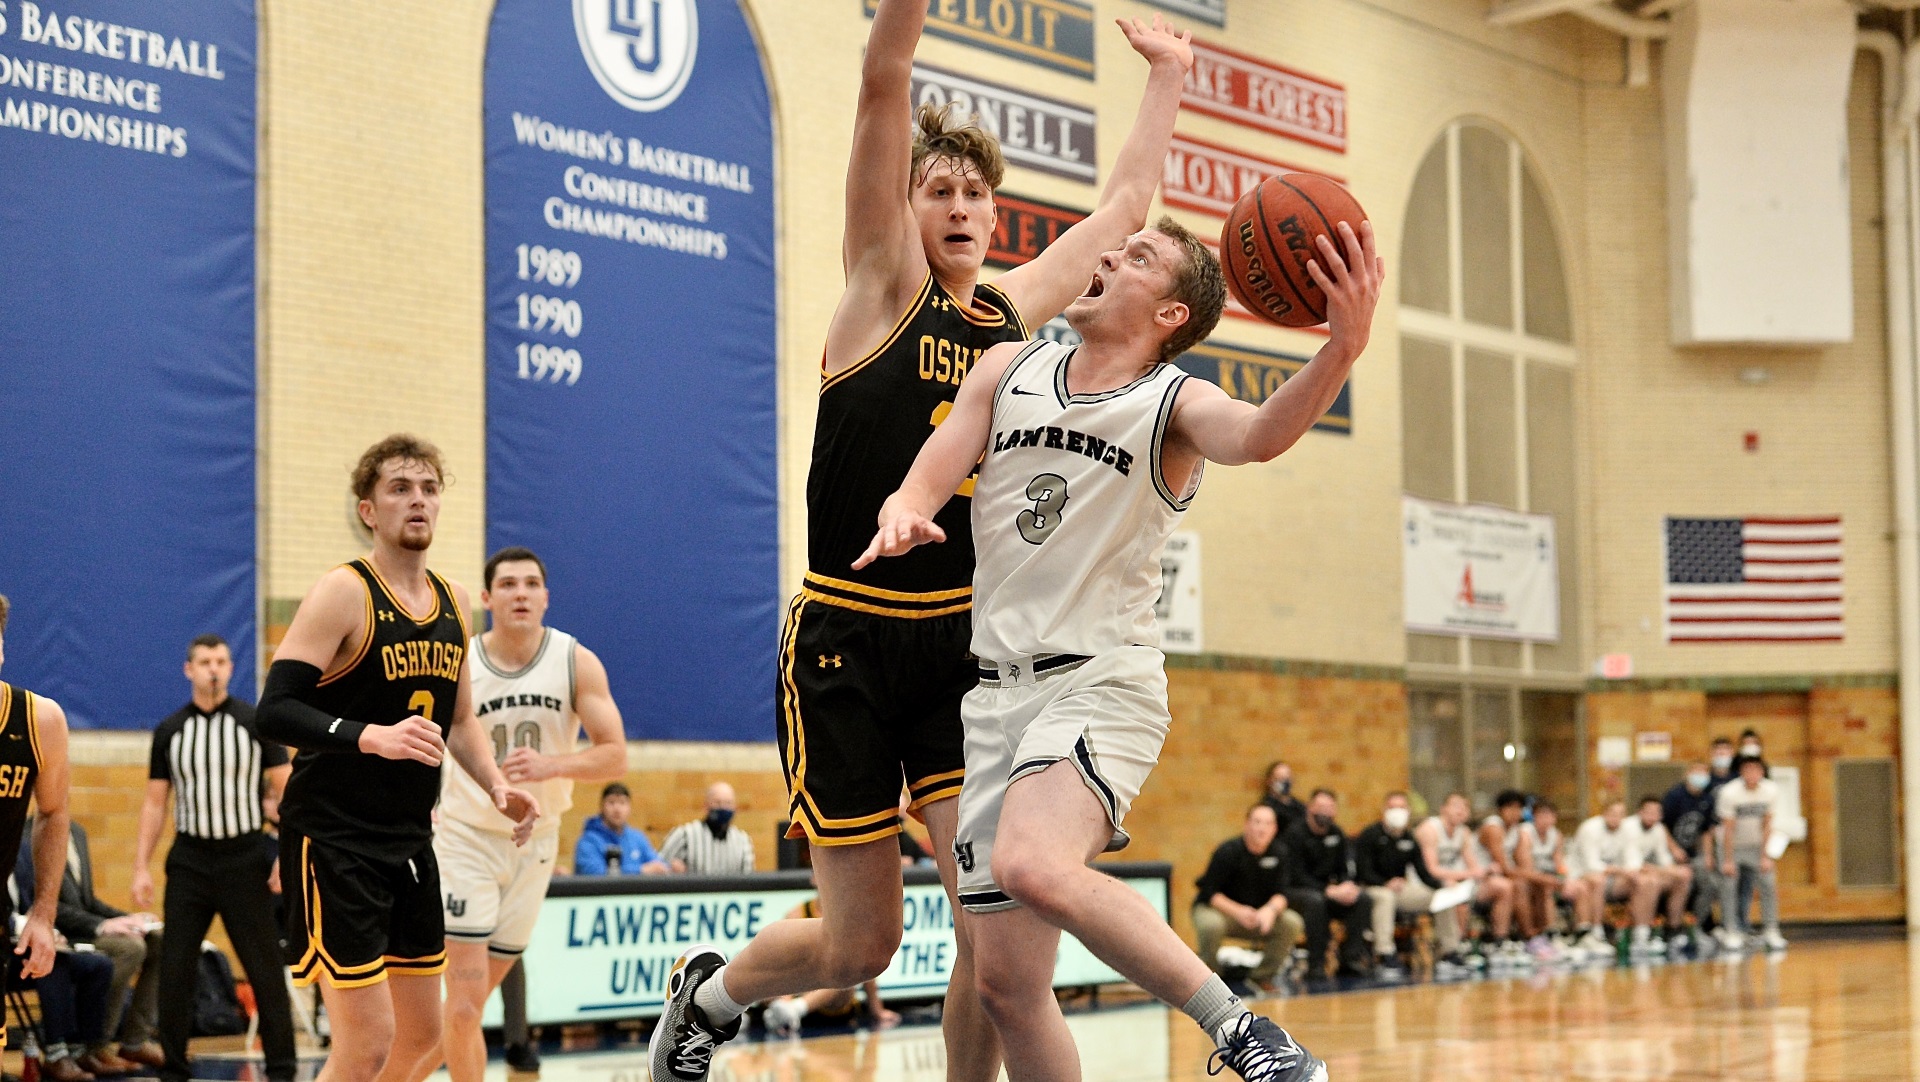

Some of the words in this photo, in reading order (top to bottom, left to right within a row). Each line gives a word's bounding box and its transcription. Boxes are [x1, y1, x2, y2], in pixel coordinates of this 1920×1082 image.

[20, 1, 226, 81] BASKETBALL
[937, 0, 1059, 50] ELOIT
[0, 53, 162, 113] ONFERENCE
[1183, 58, 1234, 106] AKE
[1248, 72, 1346, 138] FOREST
[627, 137, 754, 194] BASKETBALL
[563, 165, 709, 223] CONFERENCE
[543, 196, 729, 261] CHAMPIONSHIPS
[515, 243, 583, 289] 1989
[1238, 218, 1294, 318] Wilson
[515, 292, 583, 338] 1990
[515, 342, 583, 387] 1999
[1218, 358, 1291, 405] KNO
[993, 425, 1135, 478] LAWRENCE
[1016, 472, 1071, 546] 3
[381, 640, 464, 682] OSHKOSH
[475, 694, 562, 718] AWRENCE
[567, 902, 764, 947] LAWRENCE
[902, 942, 948, 975] THE
